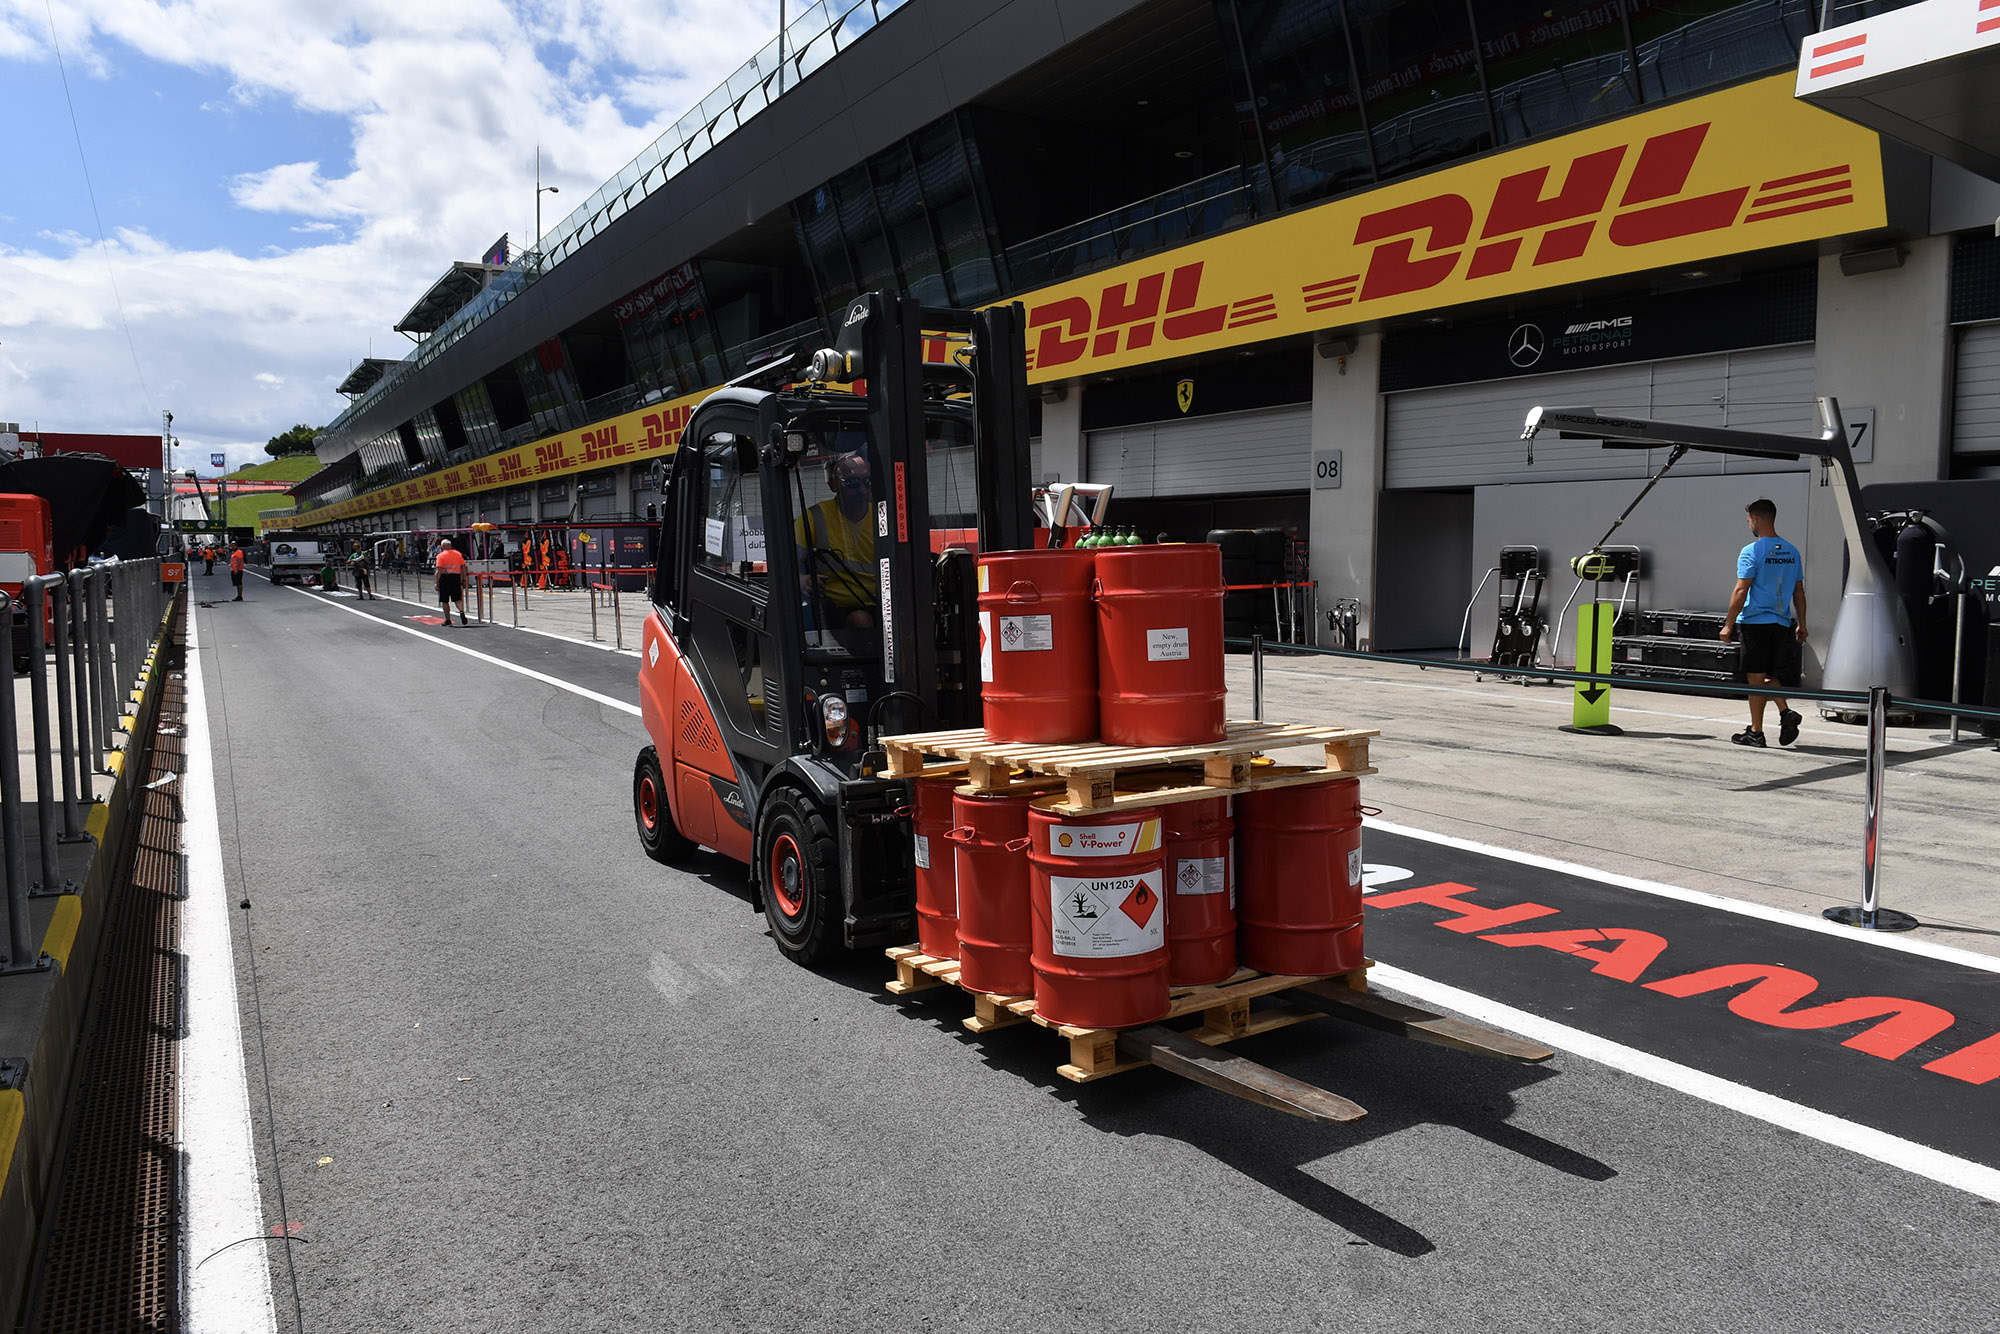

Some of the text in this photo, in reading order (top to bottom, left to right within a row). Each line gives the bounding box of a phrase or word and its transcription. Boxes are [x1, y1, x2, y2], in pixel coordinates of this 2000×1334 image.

[1354, 122, 1750, 302] DHL
[844, 304, 870, 327] Linde
[1027, 261, 1228, 368] DHL
[1585, 316, 1632, 332] AMG
[1552, 328, 1632, 347] PETRONAS
[1563, 339, 1632, 354] MOTORSPORT
[581, 425, 626, 462] DHL
[1850, 423, 1868, 448] 7
[535, 441, 569, 473] DHL
[468, 462, 494, 486] DHL
[498, 453, 528, 482] DHL
[1317, 460, 1337, 478] 08
[1765, 557, 1796, 565] PETRONAS
[1970, 578, 2000, 591] PE
[1153, 642, 1171, 650] empty
[1162, 633, 1179, 641] New,
[723, 791, 745, 809] Linde
[1080, 840, 1123, 848] V-Power
[1091, 879, 1135, 891] UN1203
